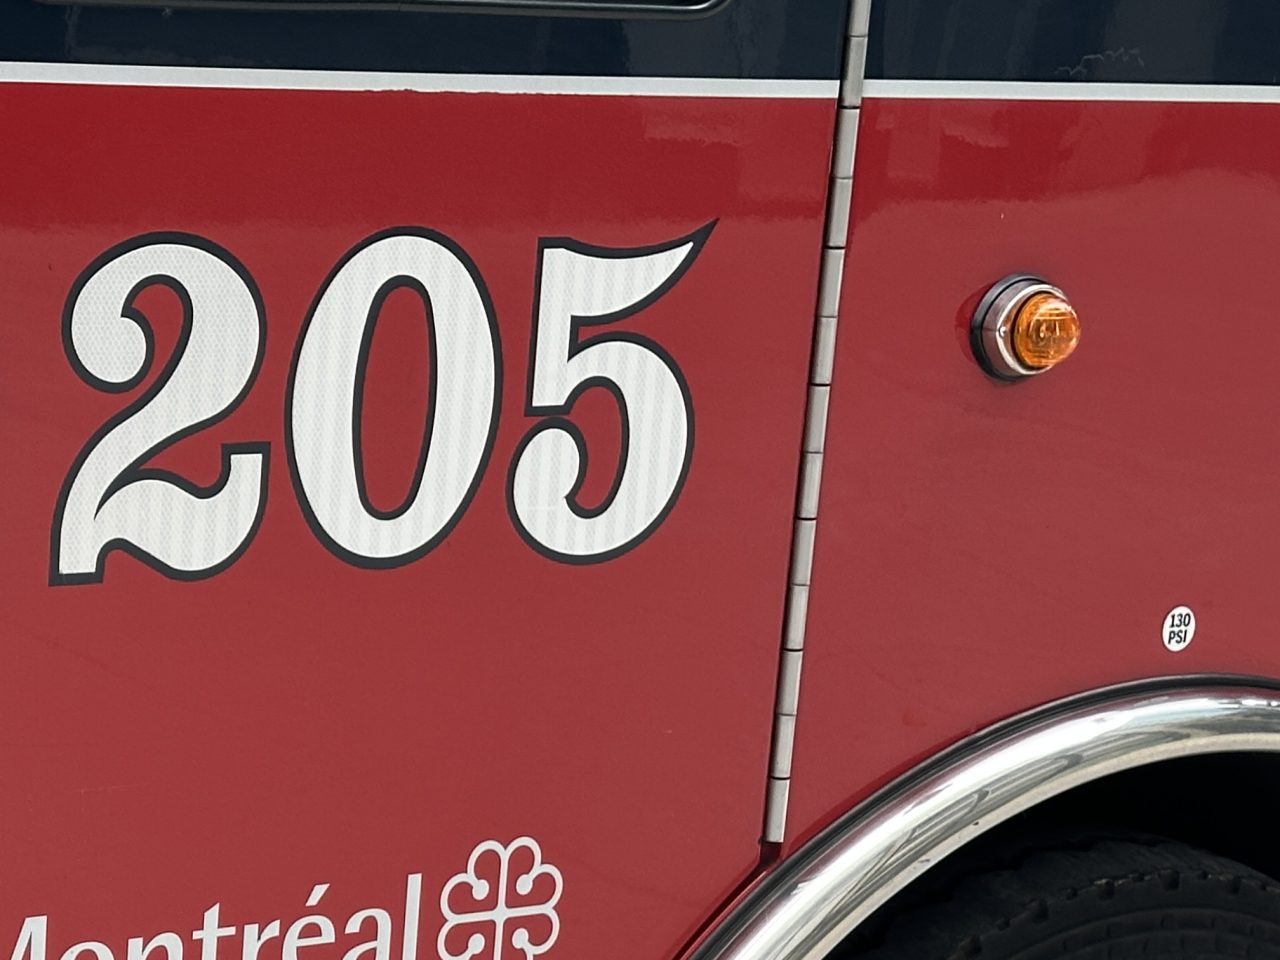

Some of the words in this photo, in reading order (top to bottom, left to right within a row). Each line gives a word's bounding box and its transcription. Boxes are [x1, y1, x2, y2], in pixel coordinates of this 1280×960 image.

[48, 218, 719, 587] 205
[1169, 612, 1191, 628] 130
[1168, 629, 1188, 645] PSI
